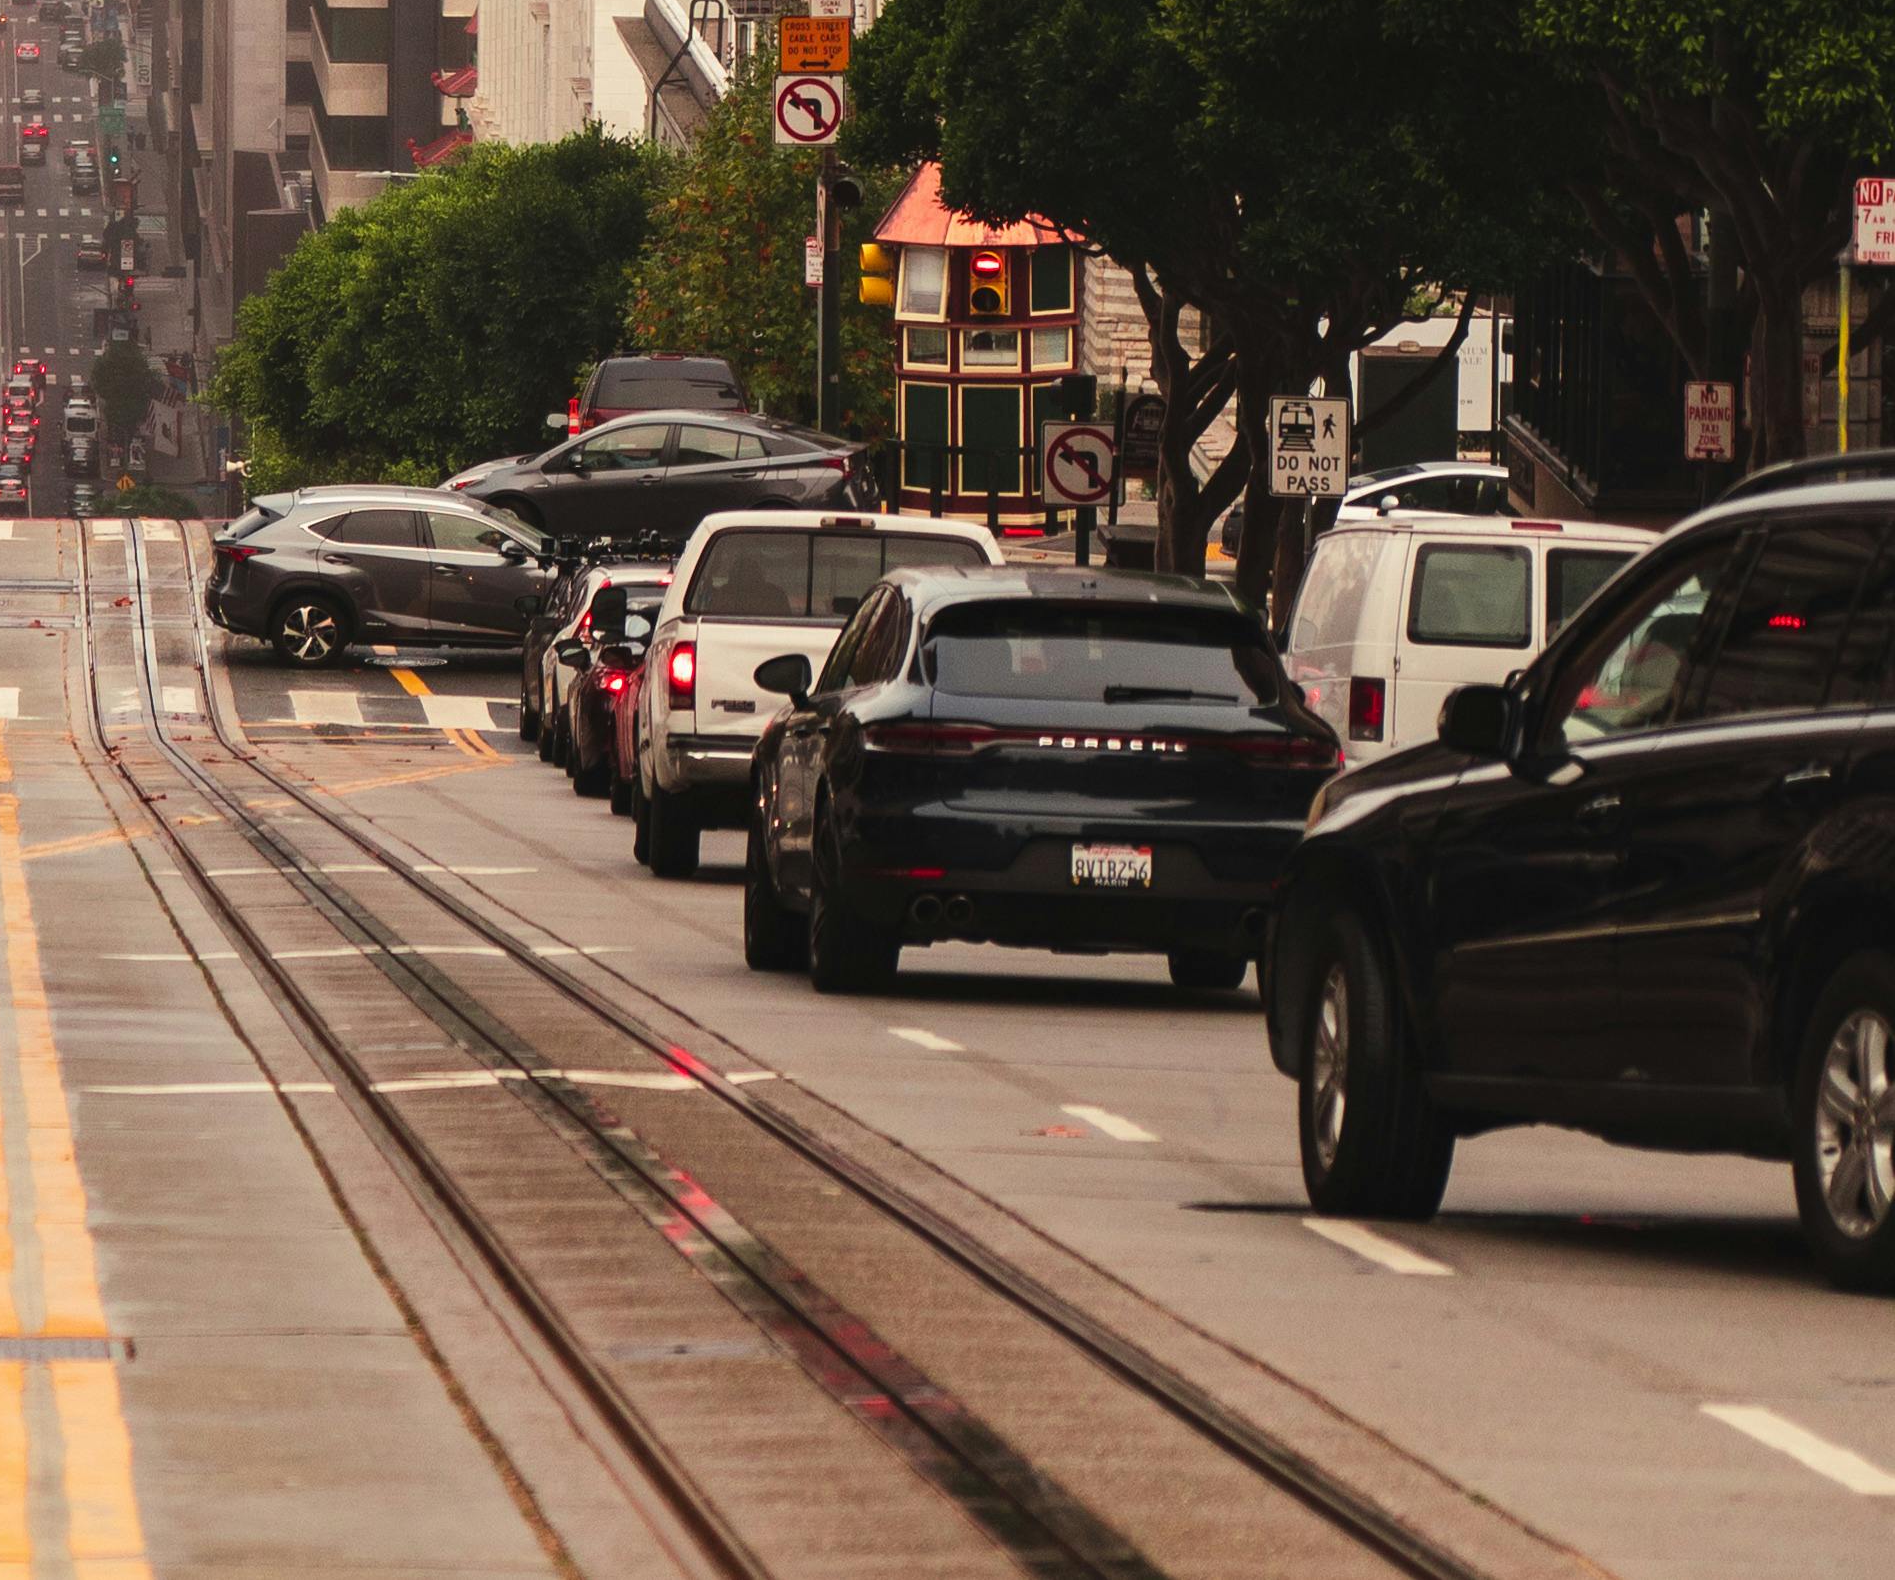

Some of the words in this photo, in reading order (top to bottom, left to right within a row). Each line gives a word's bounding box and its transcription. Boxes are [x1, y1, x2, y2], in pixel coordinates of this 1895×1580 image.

[785, 23, 810, 31] CROSS
[816, 22, 846, 31] STREET
[790, 35, 813, 43] CABLE
[788, 47, 799, 55] DO
[823, 46, 843, 55] STOP
[1860, 181, 1880, 203] NO
[1862, 251, 1890, 260] STREET
[1700, 389, 1719, 404] NO
[1689, 407, 1731, 421] PARKING
[1701, 424, 1719, 434] TAXI
[1698, 435, 1721, 446] ZONE
[1277, 456, 1299, 470] DO
[1309, 456, 1340, 471] NOT
[1287, 475, 1330, 492] PASS
[1075, 859, 1148, 880] 8VIB256
